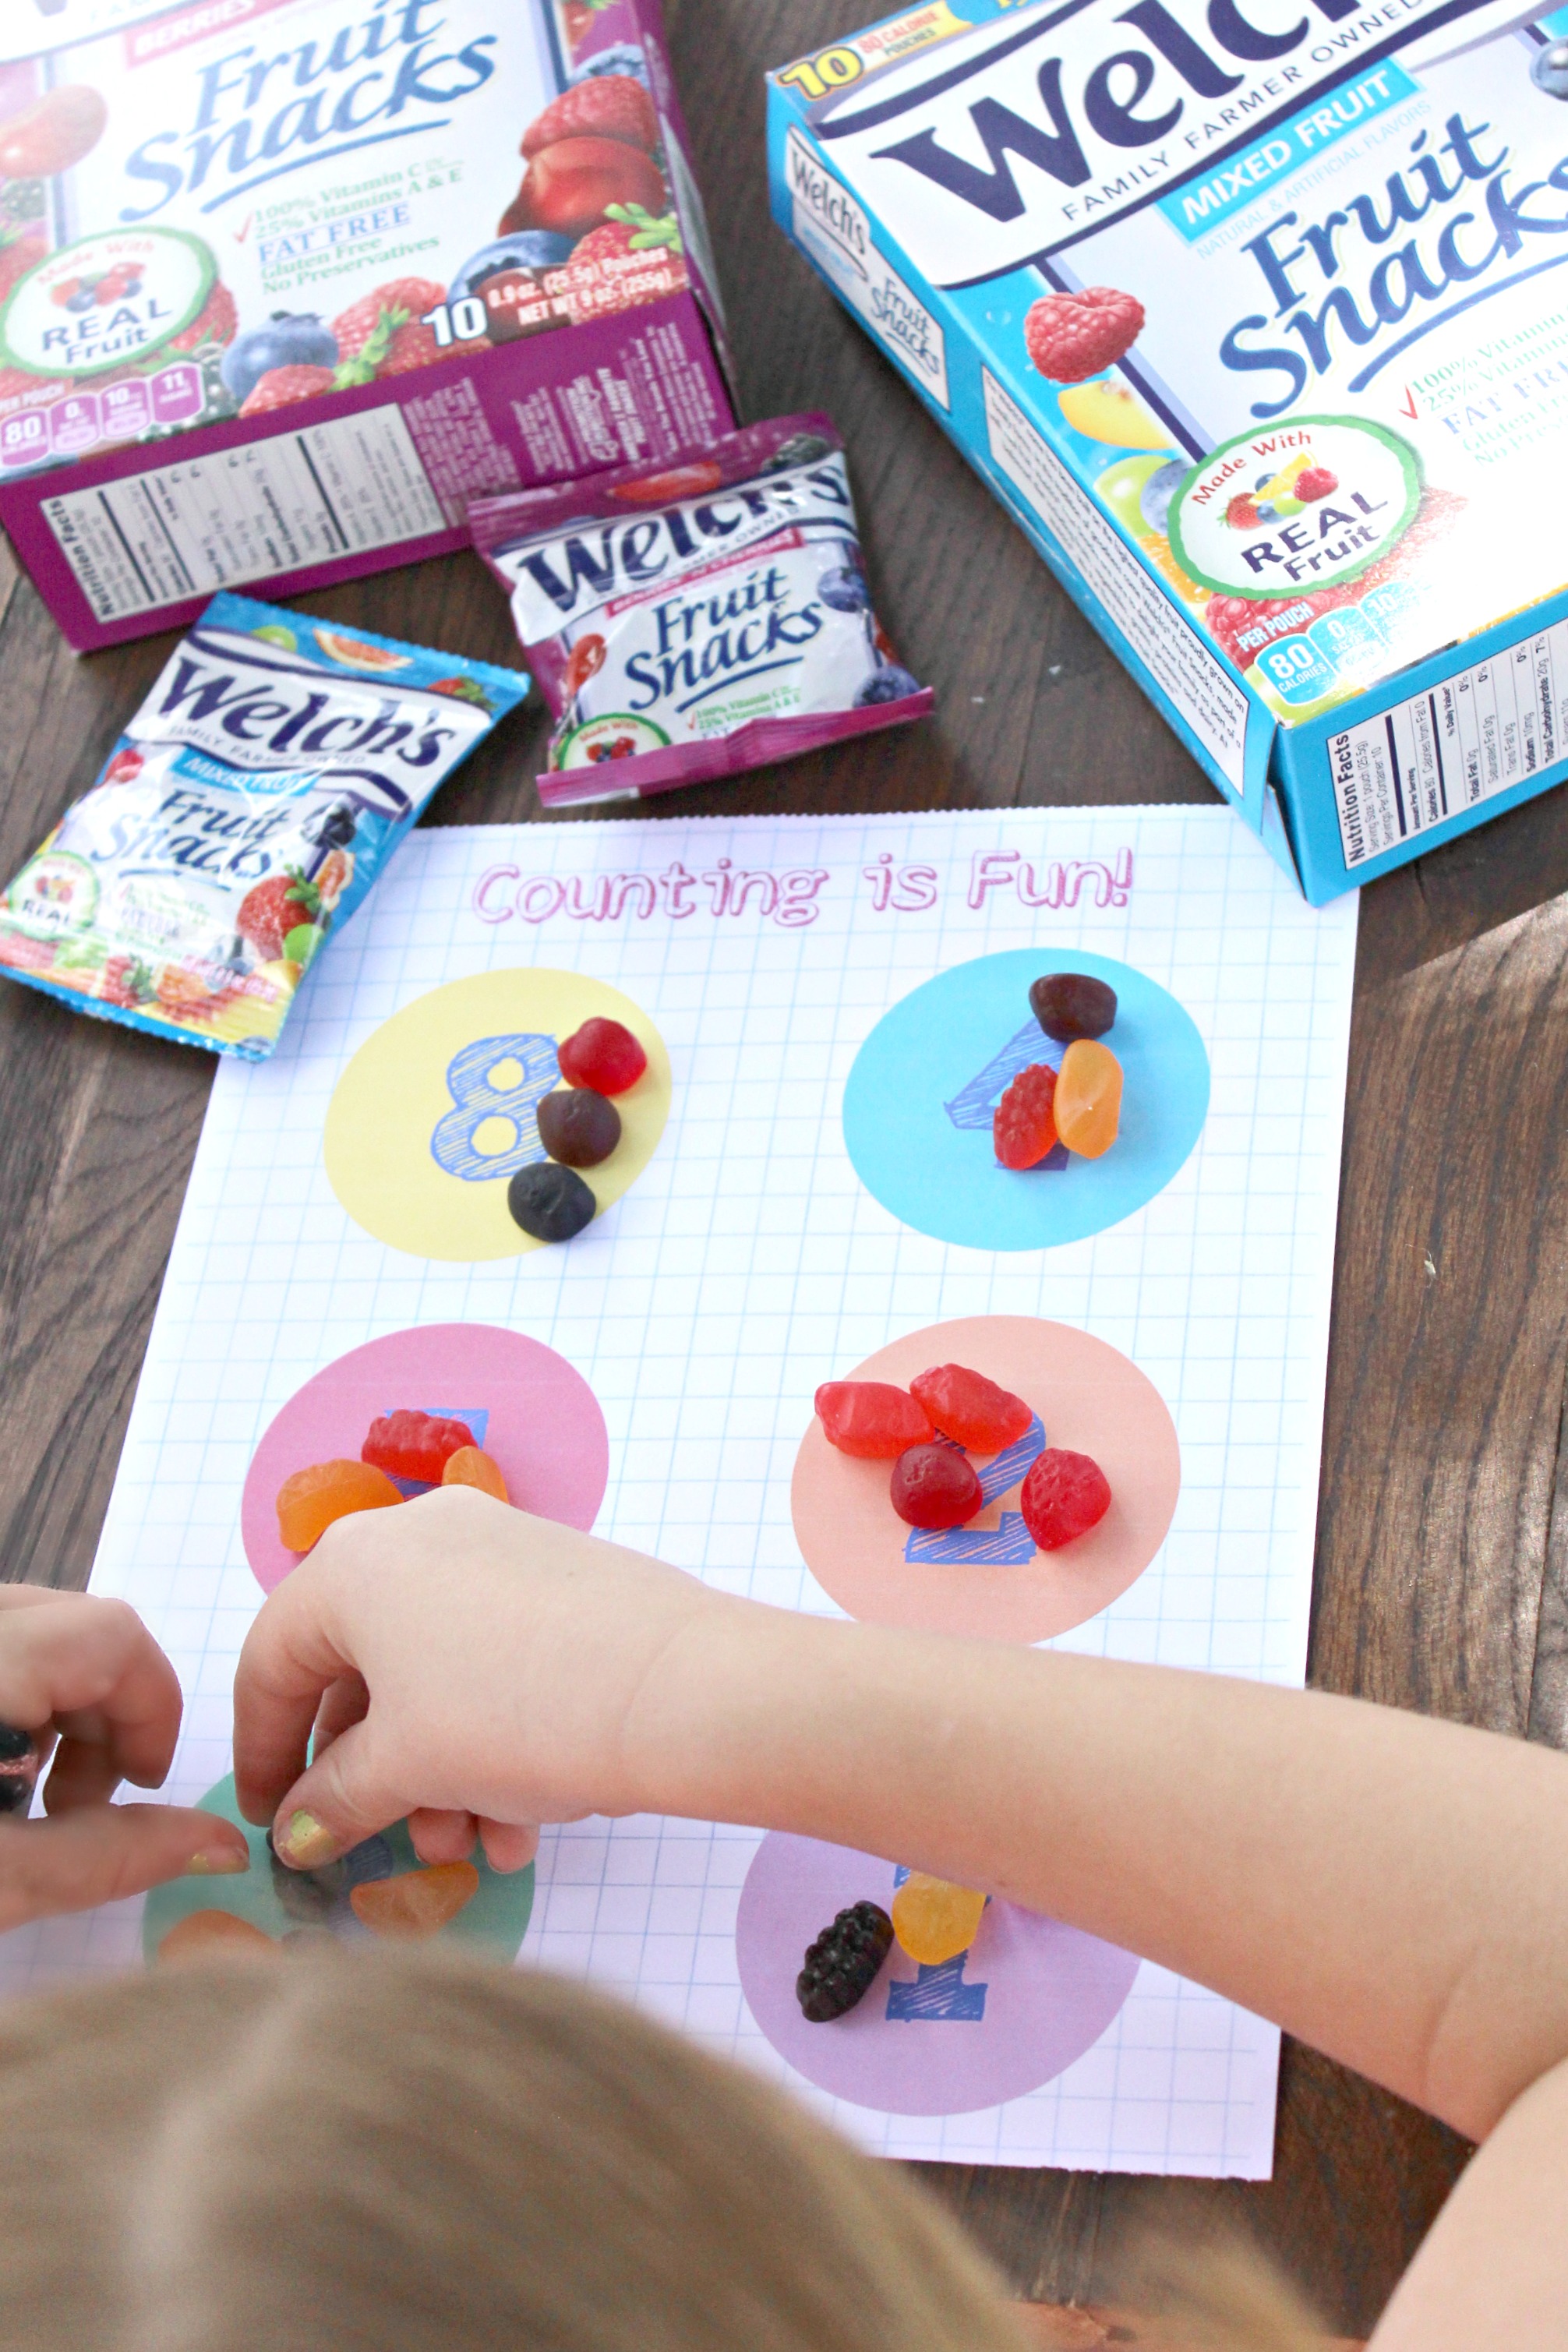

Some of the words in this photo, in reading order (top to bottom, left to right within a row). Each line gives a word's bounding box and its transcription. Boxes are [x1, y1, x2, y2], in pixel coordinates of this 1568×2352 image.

[186, 0, 448, 137] Fruit
[776, 47, 864, 100] 10
[119, 35, 499, 223] Snacks
[867, 0, 1360, 223] Welc
[1063, 150, 1169, 221] FAMILY
[1185, 66, 1303, 150] FARMER
[1181, 140, 1291, 223] MIXED
[1294, 69, 1396, 147] FRUIT
[793, 148, 867, 256] Welch's
[1240, 112, 1510, 319] Fruit
[257, 231, 314, 262] FAT
[327, 204, 411, 243] FREE
[41, 298, 174, 351] REAL
[422, 297, 488, 347] 10
[870, 285, 941, 376] Snacks
[883, 278, 931, 340] Fruit
[65, 327, 149, 365] Fruit
[1411, 355, 1478, 394] 100%
[1477, 313, 1566, 358] Vitamin
[5, 415, 41, 444] 80
[105, 387, 129, 405] 10
[1423, 378, 1479, 411] 25%
[1441, 392, 1503, 435] FAT
[1192, 457, 1247, 505] Made
[1251, 431, 1312, 457] With
[43, 498, 81, 544] Facts
[1241, 491, 1389, 574] REAL
[1283, 524, 1381, 582] Fruit
[66, 544, 118, 616] Nutrition
[652, 567, 792, 656] Fruit
[1235, 626, 1269, 653] PER
[1265, 600, 1316, 641] POUCH
[625, 601, 823, 712] Snacks
[1180, 626, 1207, 669] proudly
[1210, 666, 1232, 701] grown
[1234, 698, 1243, 712] on
[1268, 644, 1315, 680] 80
[1515, 644, 1527, 665] 0%
[1534, 634, 1545, 654] 7%
[1278, 662, 1329, 694] CALORIES
[1457, 673, 1469, 694] 0%
[1476, 663, 1489, 684] 0%
[157, 656, 457, 768] Welch's
[1217, 694, 1236, 722] made
[1414, 705, 1427, 724] Fat
[1417, 720, 1429, 743] from
[1443, 706, 1456, 729] Daily
[1538, 673, 1552, 742] Carbohydrate
[1329, 732, 1354, 786] Facts
[1370, 744, 1382, 759] 10
[1419, 739, 1433, 775] Calories
[1483, 726, 1495, 745] Fat
[1503, 733, 1515, 752] Fat
[1505, 748, 1517, 775] Trans
[1524, 734, 1536, 774] Sodium
[1544, 736, 1555, 763] Total
[1358, 768, 1373, 797] pouch
[1467, 760, 1478, 779] Fat
[1468, 775, 1480, 802] Total
[1485, 740, 1499, 785] Saturated
[148, 788, 293, 841] Fruit
[1339, 782, 1366, 863] Nutrition
[1378, 795, 1390, 813] Per
[1380, 808, 1396, 846] Servings
[1425, 786, 1439, 823] Calories
[90, 813, 271, 879] Snacks
[1366, 819, 1381, 853] Serving
[471, 858, 829, 927] Counting
[863, 850, 938, 913] is
[966, 847, 1134, 910] Fun!
[430, 1033, 563, 1181] 8
[902, 1411, 1047, 1566] 2
